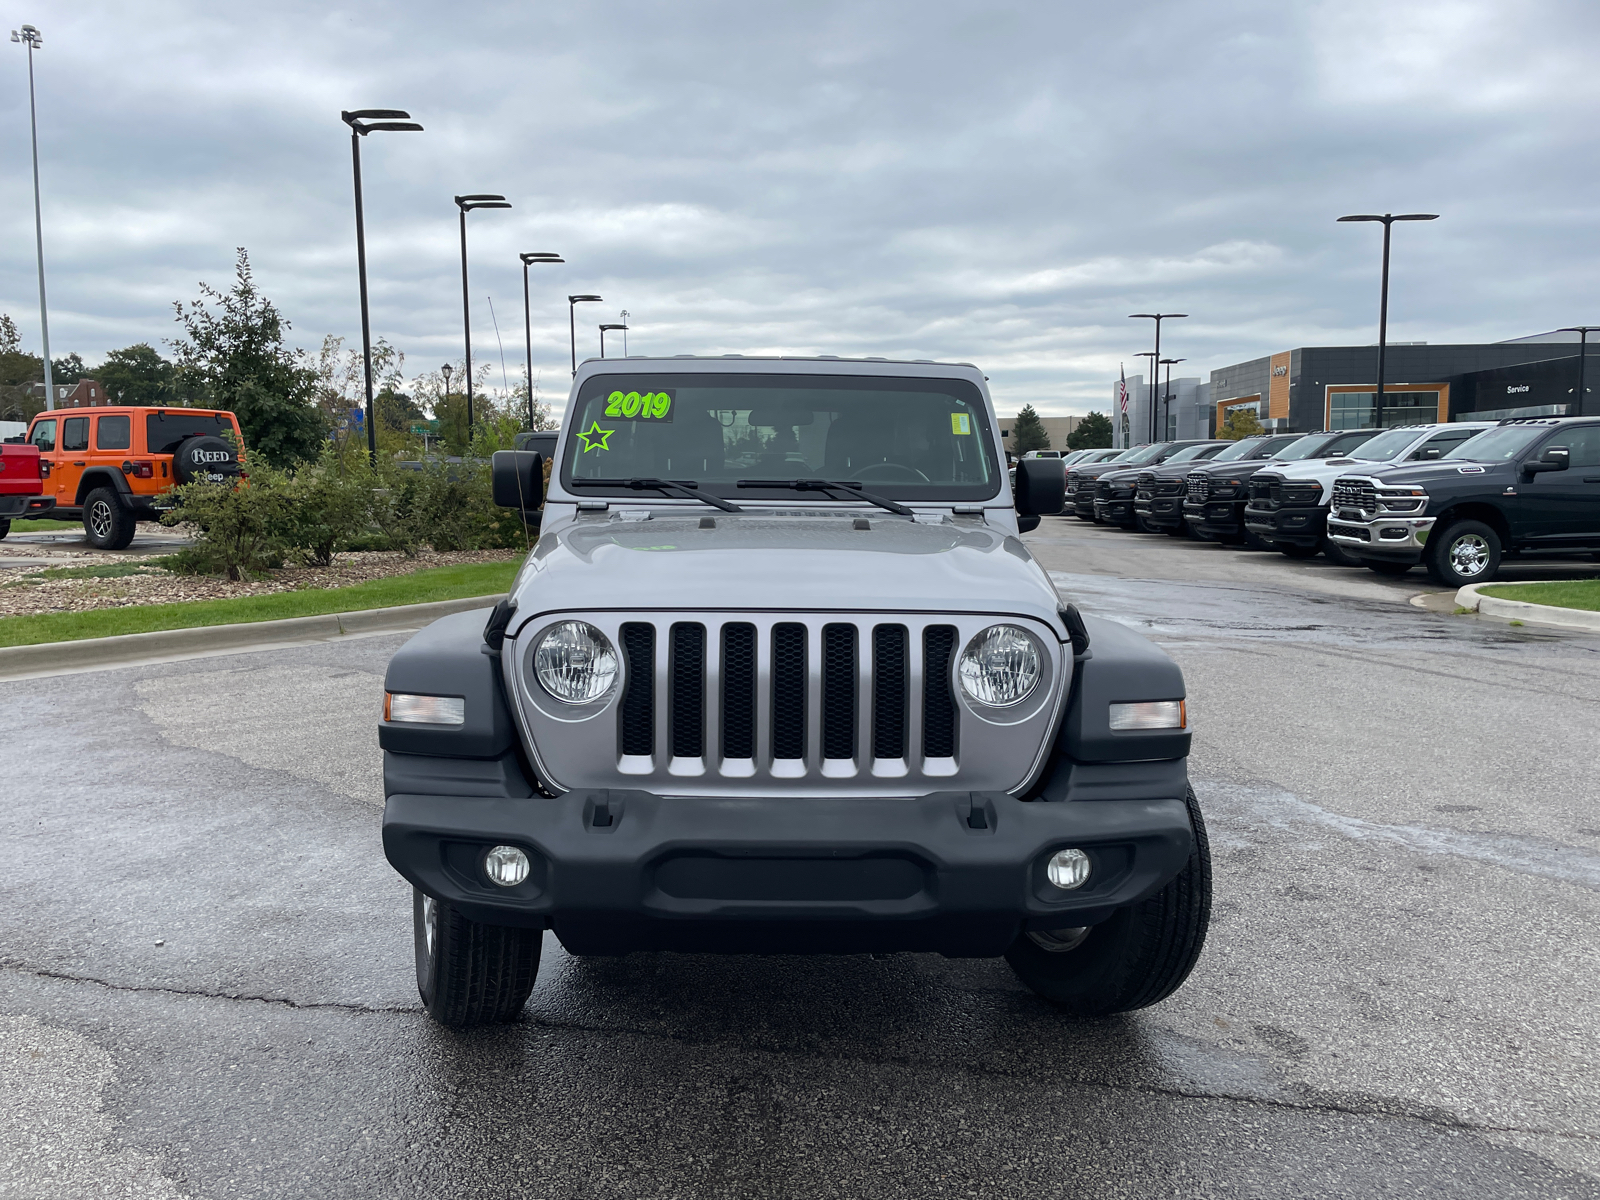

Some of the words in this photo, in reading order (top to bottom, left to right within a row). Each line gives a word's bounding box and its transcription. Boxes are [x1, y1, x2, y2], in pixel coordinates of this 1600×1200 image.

[1272, 365, 1287, 377] Jeep
[1507, 384, 1530, 394] Service
[605, 390, 671, 419] 2019
[203, 473, 223, 481] eep
